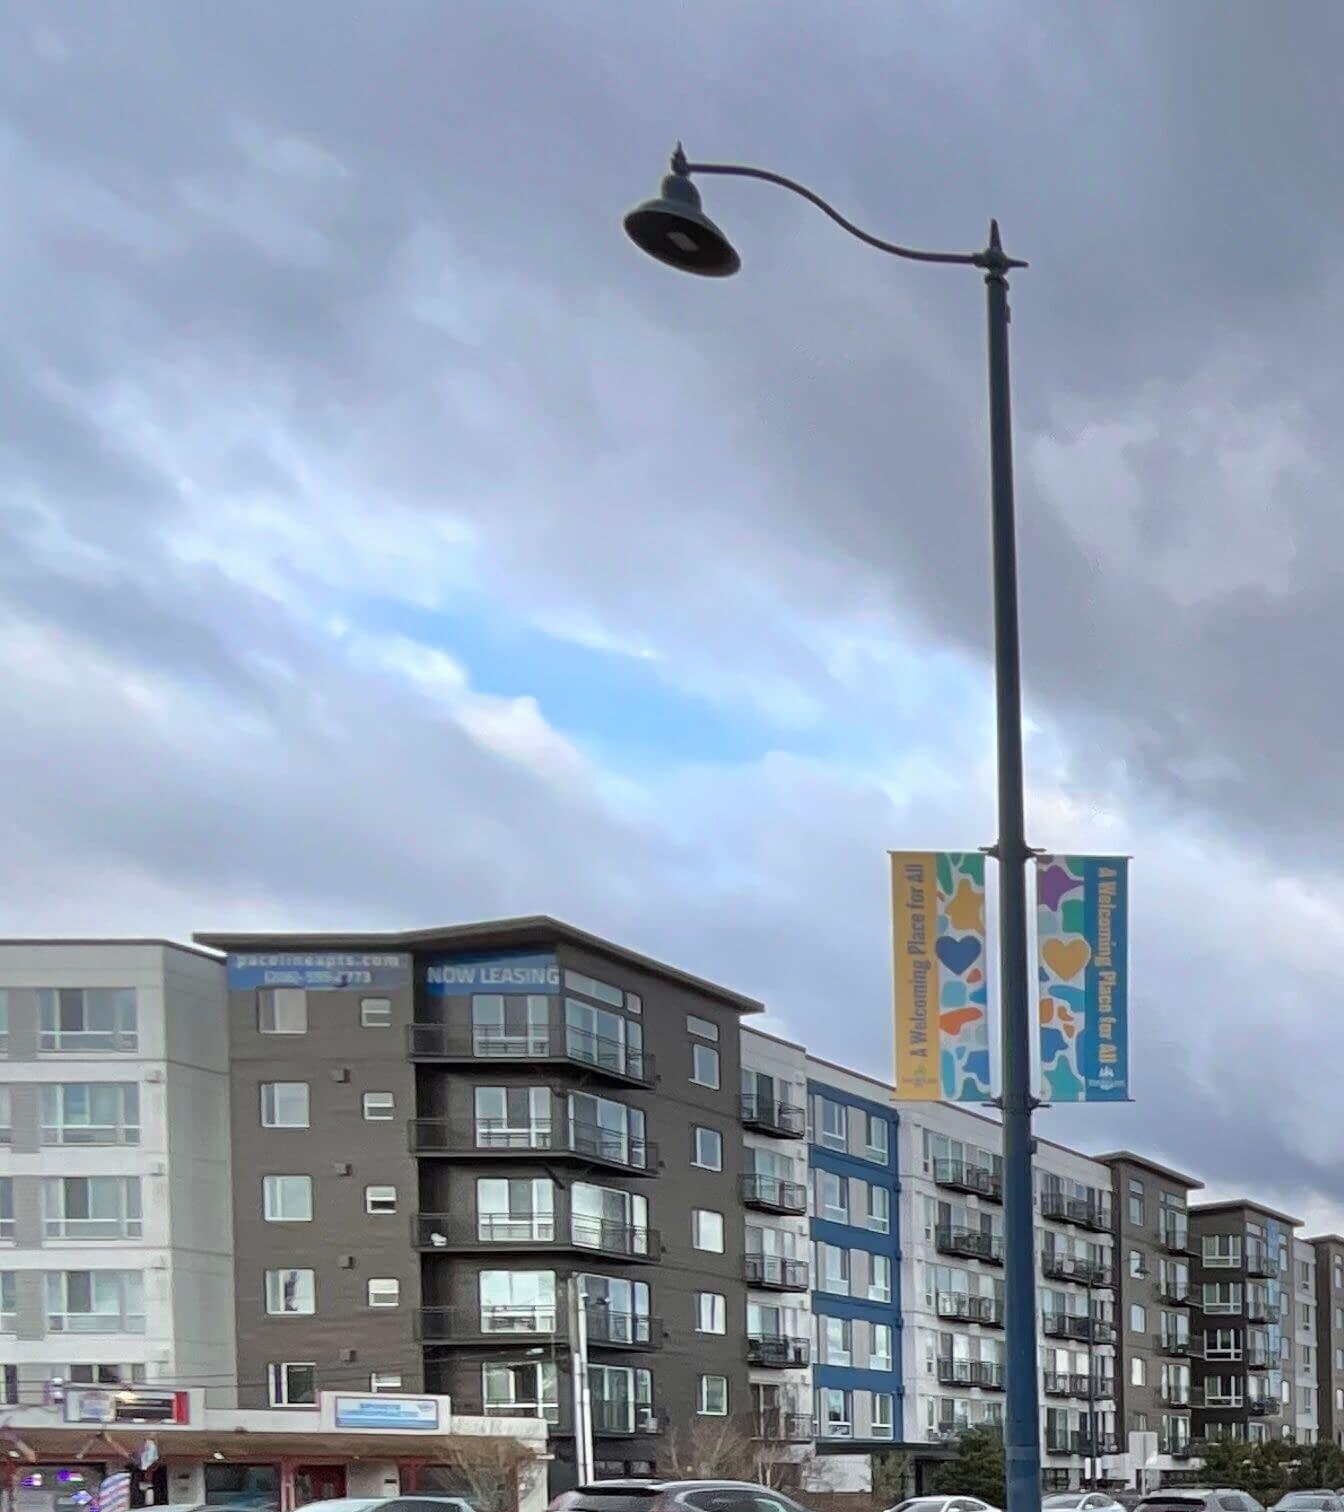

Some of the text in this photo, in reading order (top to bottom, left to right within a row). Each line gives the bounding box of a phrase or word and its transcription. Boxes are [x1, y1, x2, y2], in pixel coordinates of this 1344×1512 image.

[905, 864, 925, 883] All
[906, 886, 925, 909] for
[907, 913, 926, 955] Place
[427, 966, 560, 985] NOW LEASING
[1095, 867, 1118, 1063] A Welcoming Place for All
[908, 959, 931, 1045] Welcoming
